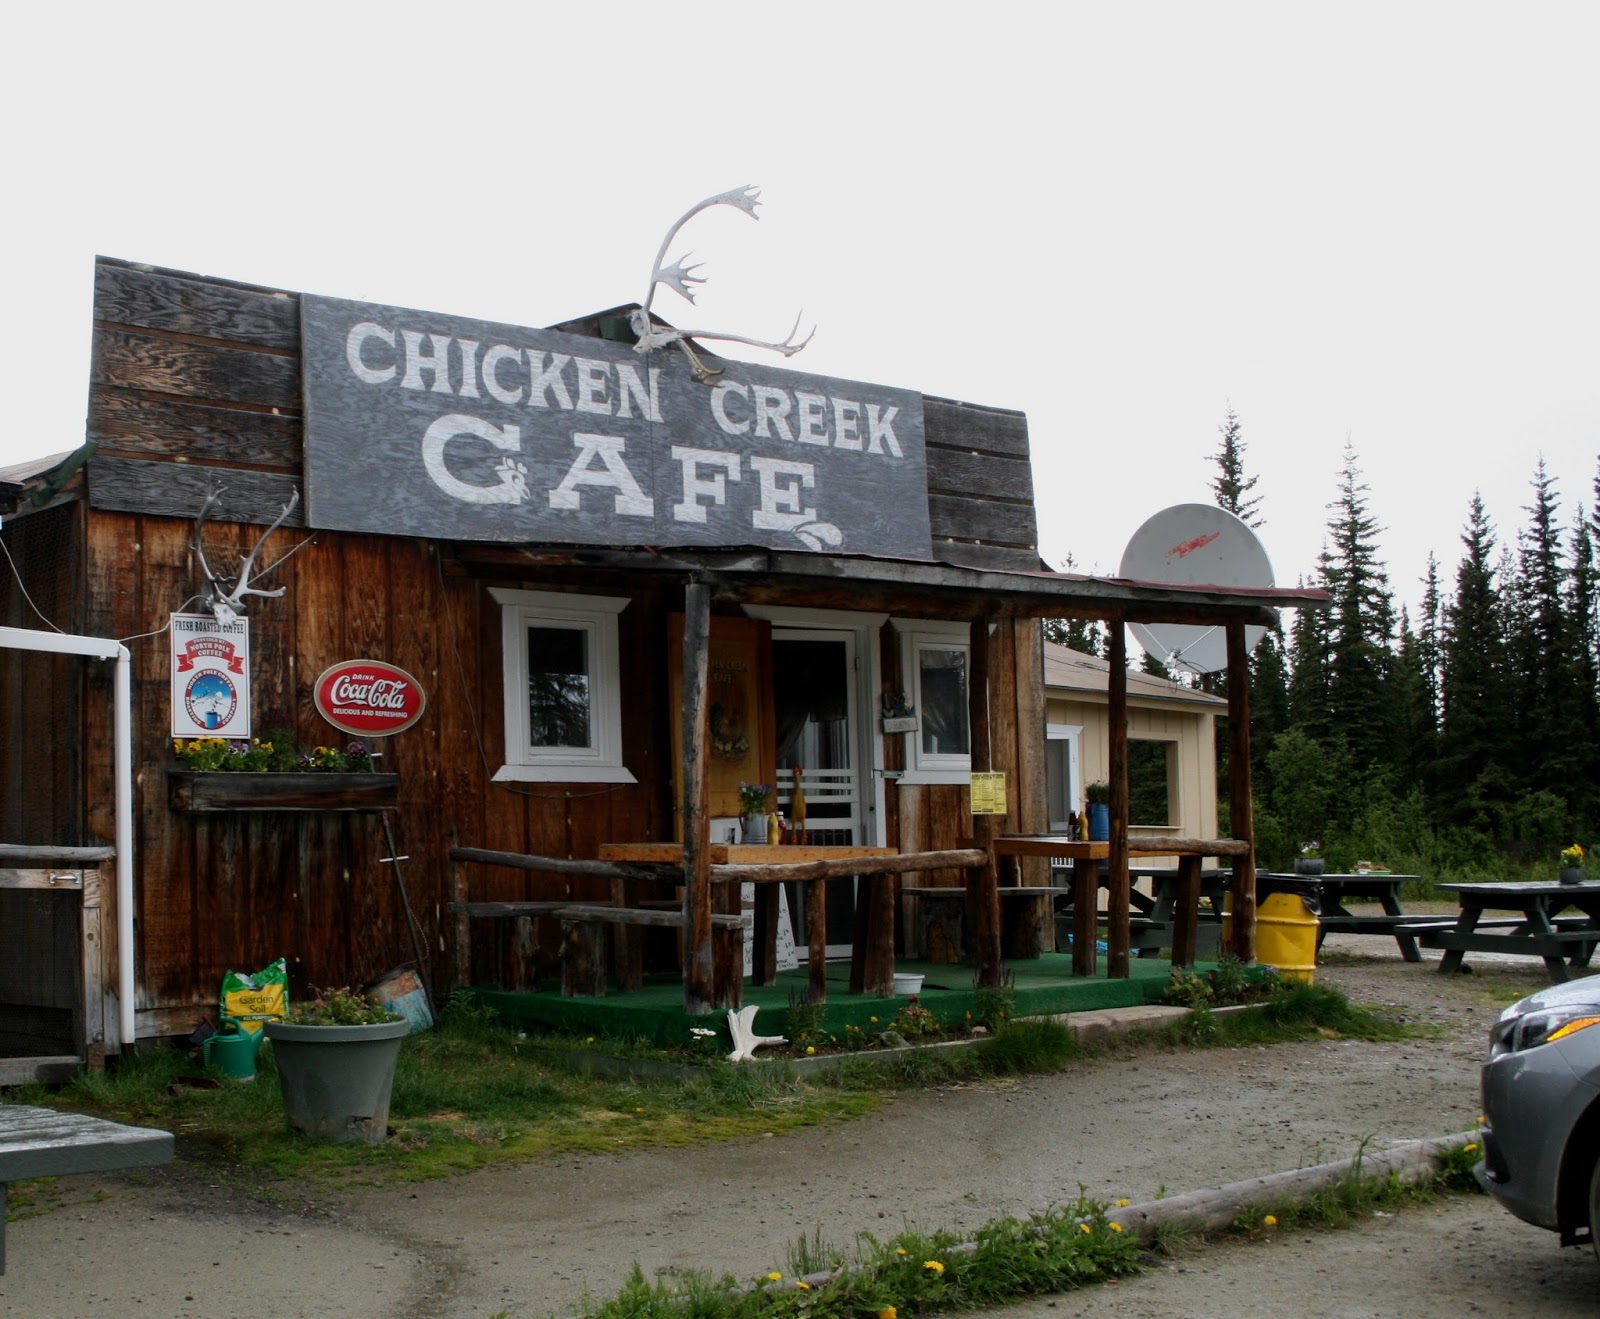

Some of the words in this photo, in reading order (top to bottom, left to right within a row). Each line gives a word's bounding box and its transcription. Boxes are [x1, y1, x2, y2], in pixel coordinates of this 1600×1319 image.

[346, 321, 665, 424] CHICKEN
[710, 381, 904, 458] CREEK
[421, 413, 843, 552] CAFE
[175, 620, 194, 631] FRESH
[194, 621, 221, 633] ROASTED
[222, 623, 244, 634] COFFEE
[190, 643, 213, 651] NORTH
[214, 643, 230, 653] POLE
[187, 671, 203, 691] NORTH
[218, 672, 235, 691] COFFEE
[352, 673, 375, 681] DRINK
[185, 696, 202, 726] ROASTING
[221, 698, 237, 726] COMPANY
[361, 709, 375, 717] AND
[239, 995, 274, 1005] Garden
[249, 1004, 266, 1013] Soil
